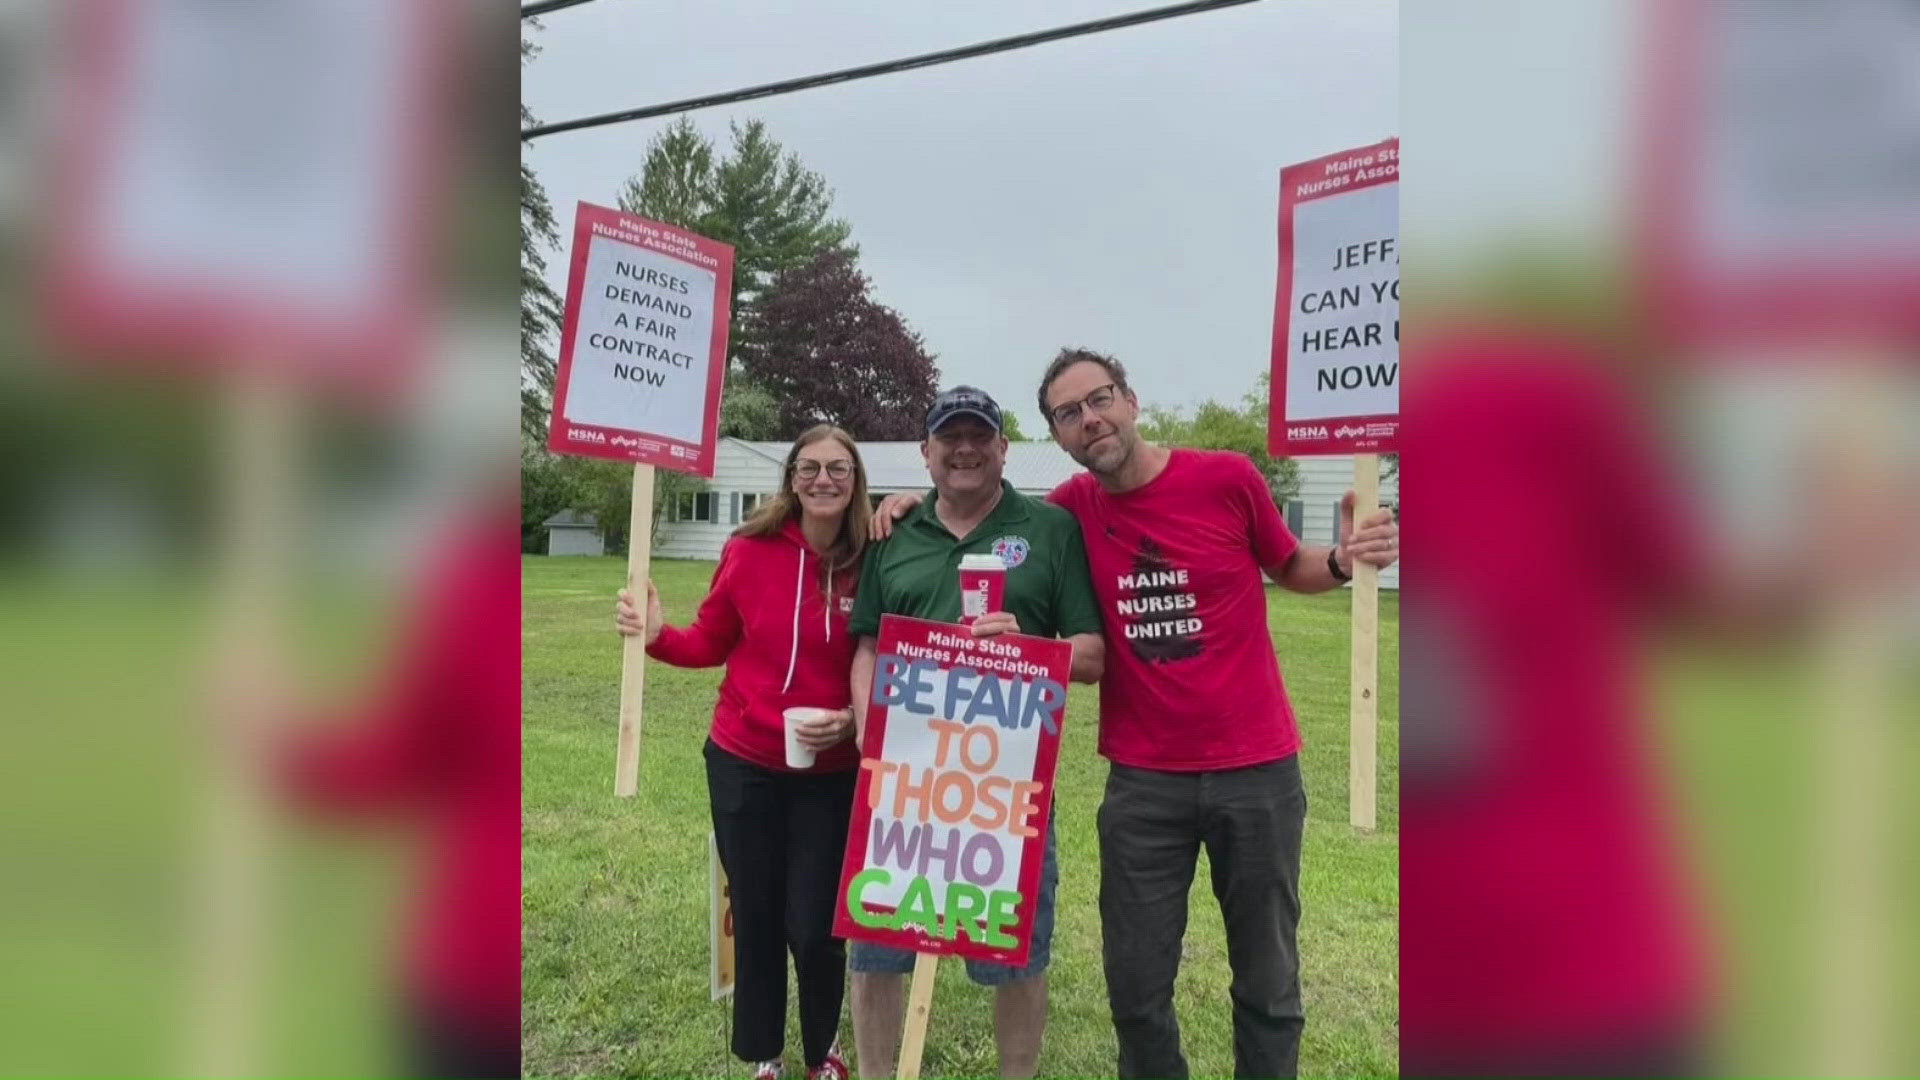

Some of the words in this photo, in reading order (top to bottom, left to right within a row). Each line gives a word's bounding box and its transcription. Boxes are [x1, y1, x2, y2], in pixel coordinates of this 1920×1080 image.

[1325, 156, 1373, 176] Maine
[1297, 175, 1350, 197] Nurses
[592, 222, 640, 243] Nurses
[643, 236, 718, 267] Association
[619, 218, 659, 238] Maine
[663, 230, 696, 249] State
[616, 261, 689, 295] NURSES
[605, 284, 692, 319] DEMAND
[1301, 285, 1360, 314] CAN
[614, 312, 628, 328] A
[635, 316, 677, 341] FAIR
[1302, 323, 1382, 353] HEAR
[589, 333, 693, 370] CONTRACT
[614, 363, 666, 388] NOW
[1317, 362, 1398, 392] NOW
[568, 428, 606, 442] MSNA
[1287, 426, 1328, 438] MSNA
[1117, 569, 1189, 590] MAINE
[1116, 593, 1197, 615] NURSES
[1124, 617, 1203, 639] UNITED
[896, 641, 950, 663] Nurses
[954, 653, 1049, 677] Association
[928, 630, 975, 651] Maine
[979, 639, 1022, 659] State
[872, 654, 938, 715] BE
[943, 666, 1066, 736] FAIR
[928, 719, 999, 774] TO
[861, 757, 1044, 838] THOSE
[872, 817, 1005, 887] WHO
[847, 868, 1023, 949] CARE
